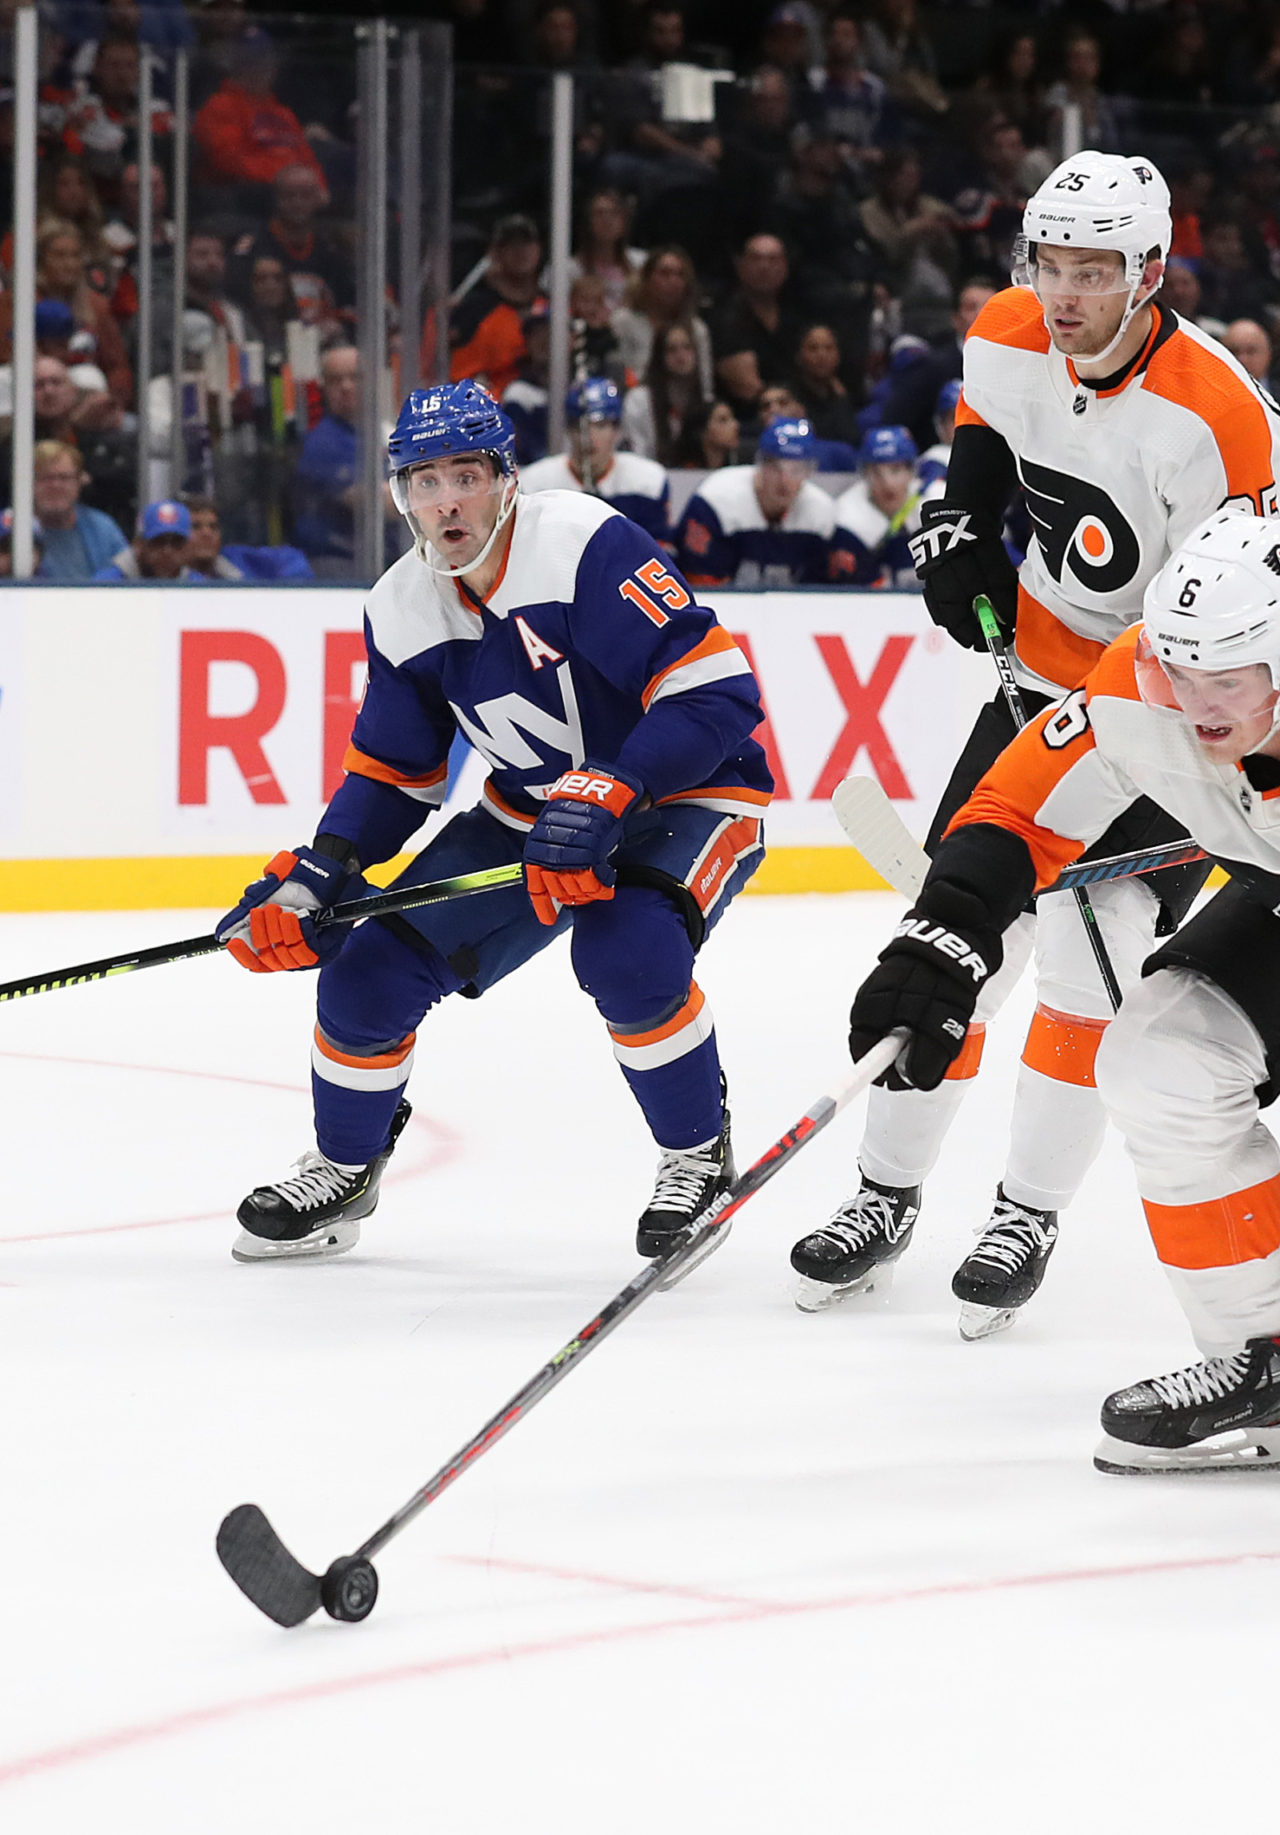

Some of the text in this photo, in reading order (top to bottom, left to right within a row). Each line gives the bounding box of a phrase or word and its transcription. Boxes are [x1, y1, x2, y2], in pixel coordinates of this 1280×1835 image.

[1055, 172, 1091, 192] 25
[1038, 213, 1076, 223] BAUER
[421, 395, 442, 414] 15
[412, 428, 450, 441] BAUER
[907, 514, 978, 569] STX
[618, 557, 691, 629] 15
[1178, 578, 1202, 608] 6
[513, 615, 564, 672] A
[1158, 632, 1200, 648] BAUER
[995, 655, 1020, 696] CCM
[1040, 686, 1091, 751] 6
[547, 774, 614, 801] UER
[300, 858, 330, 879] BAUER
[700, 856, 722, 895] BAUER
[892, 918, 988, 982] AUER
[686, 1191, 734, 1236] BAUER
